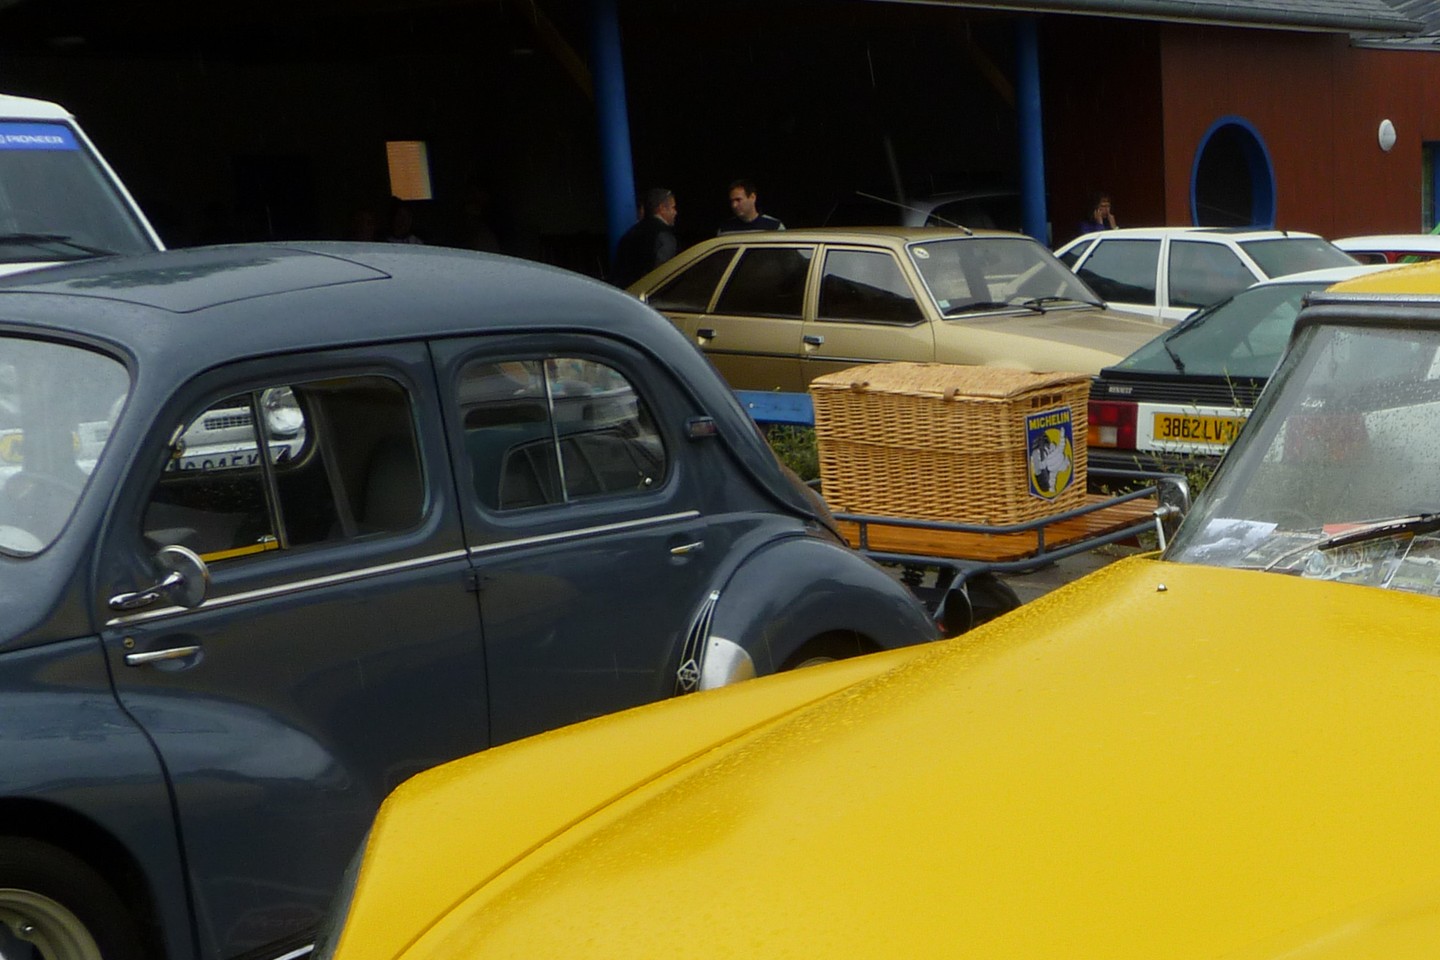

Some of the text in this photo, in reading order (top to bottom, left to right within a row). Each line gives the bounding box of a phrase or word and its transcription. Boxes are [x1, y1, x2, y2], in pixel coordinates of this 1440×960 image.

[5, 134, 63, 144] PIONEER
[1029, 410, 1070, 431] MICHELIN
[1162, 417, 1241, 441] 3862 LV 7
